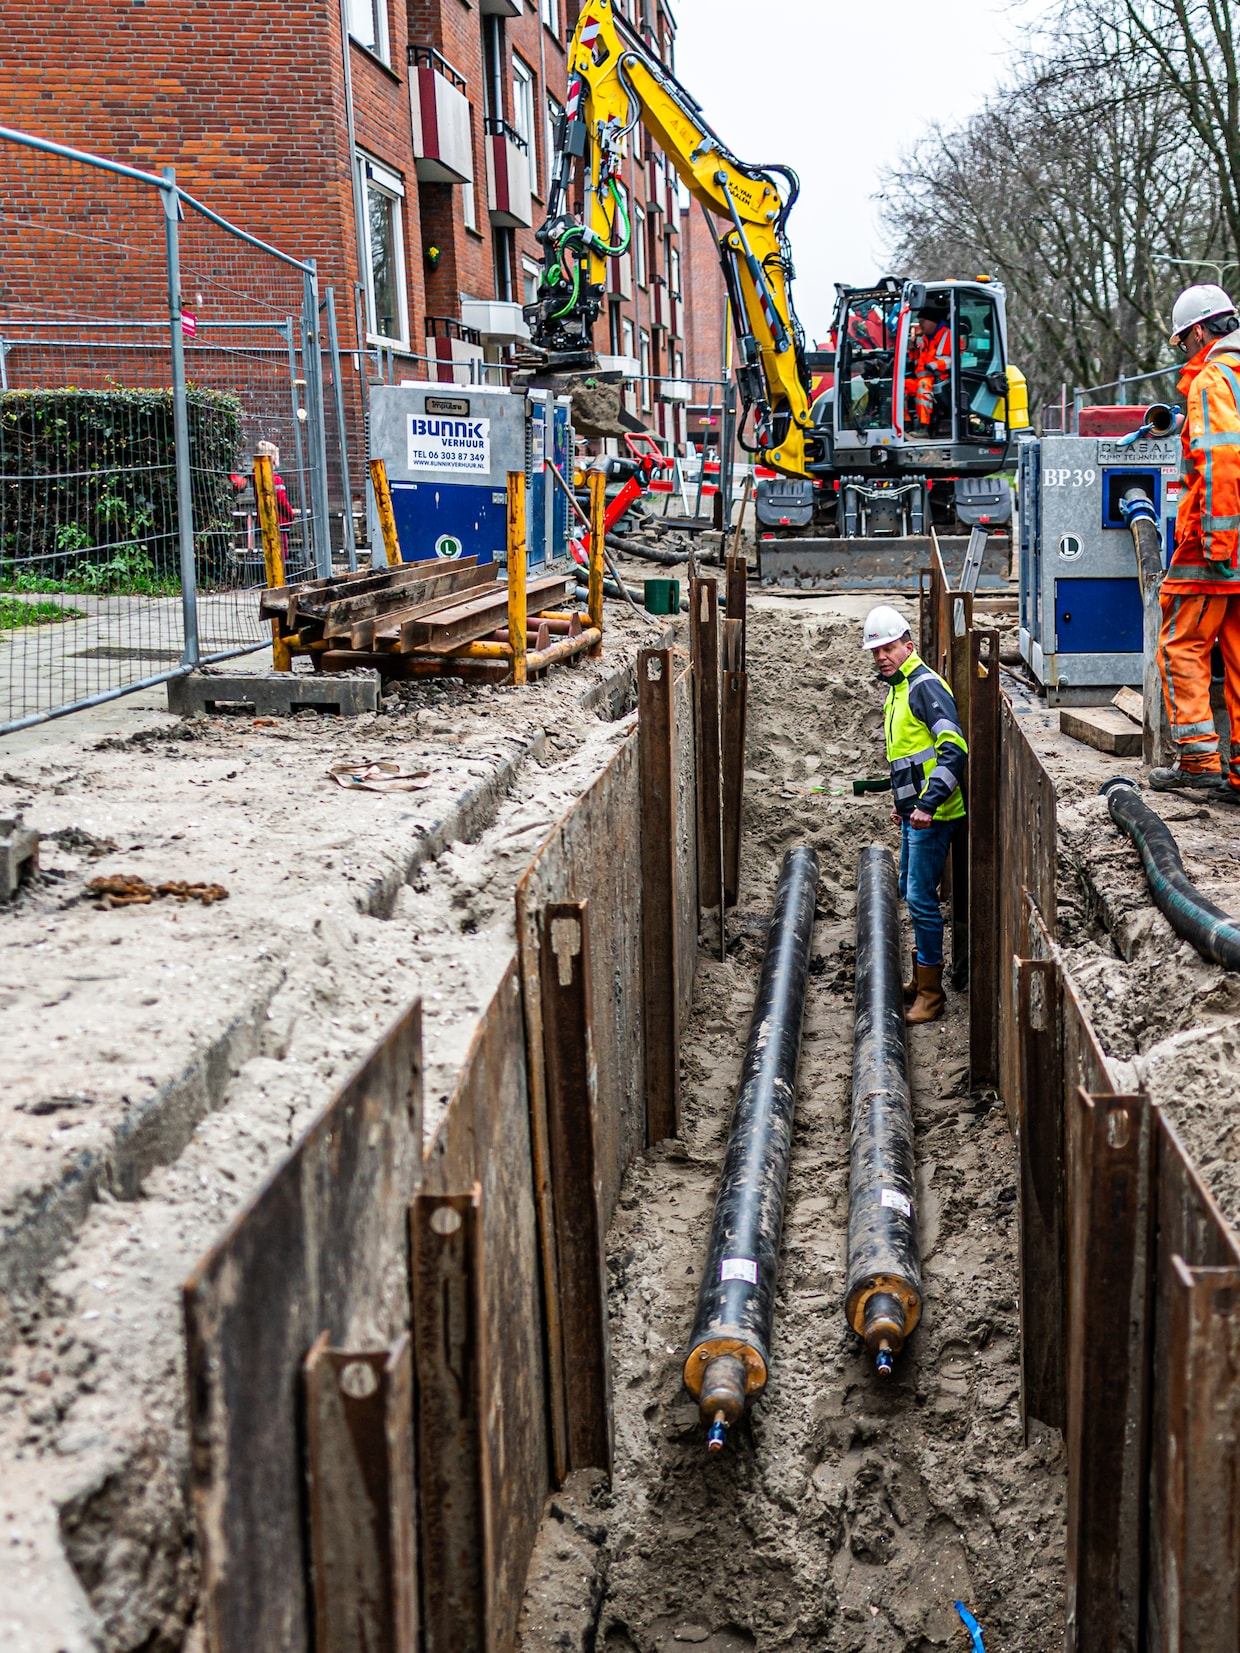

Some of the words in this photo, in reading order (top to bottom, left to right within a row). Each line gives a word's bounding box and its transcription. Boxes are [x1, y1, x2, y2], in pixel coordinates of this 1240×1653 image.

[441, 438, 485, 449] VERHUUR
[413, 450, 427, 459] TEL
[428, 451, 439, 460] 06
[440, 451, 456, 461] 303
[457, 452, 468, 461] 87
[469, 453, 485, 462] 349
[413, 460, 485, 469] WWW.BUNNIKVERHUUR.NL
[445, 542, 453, 555] L
[1063, 537, 1075, 556] L
